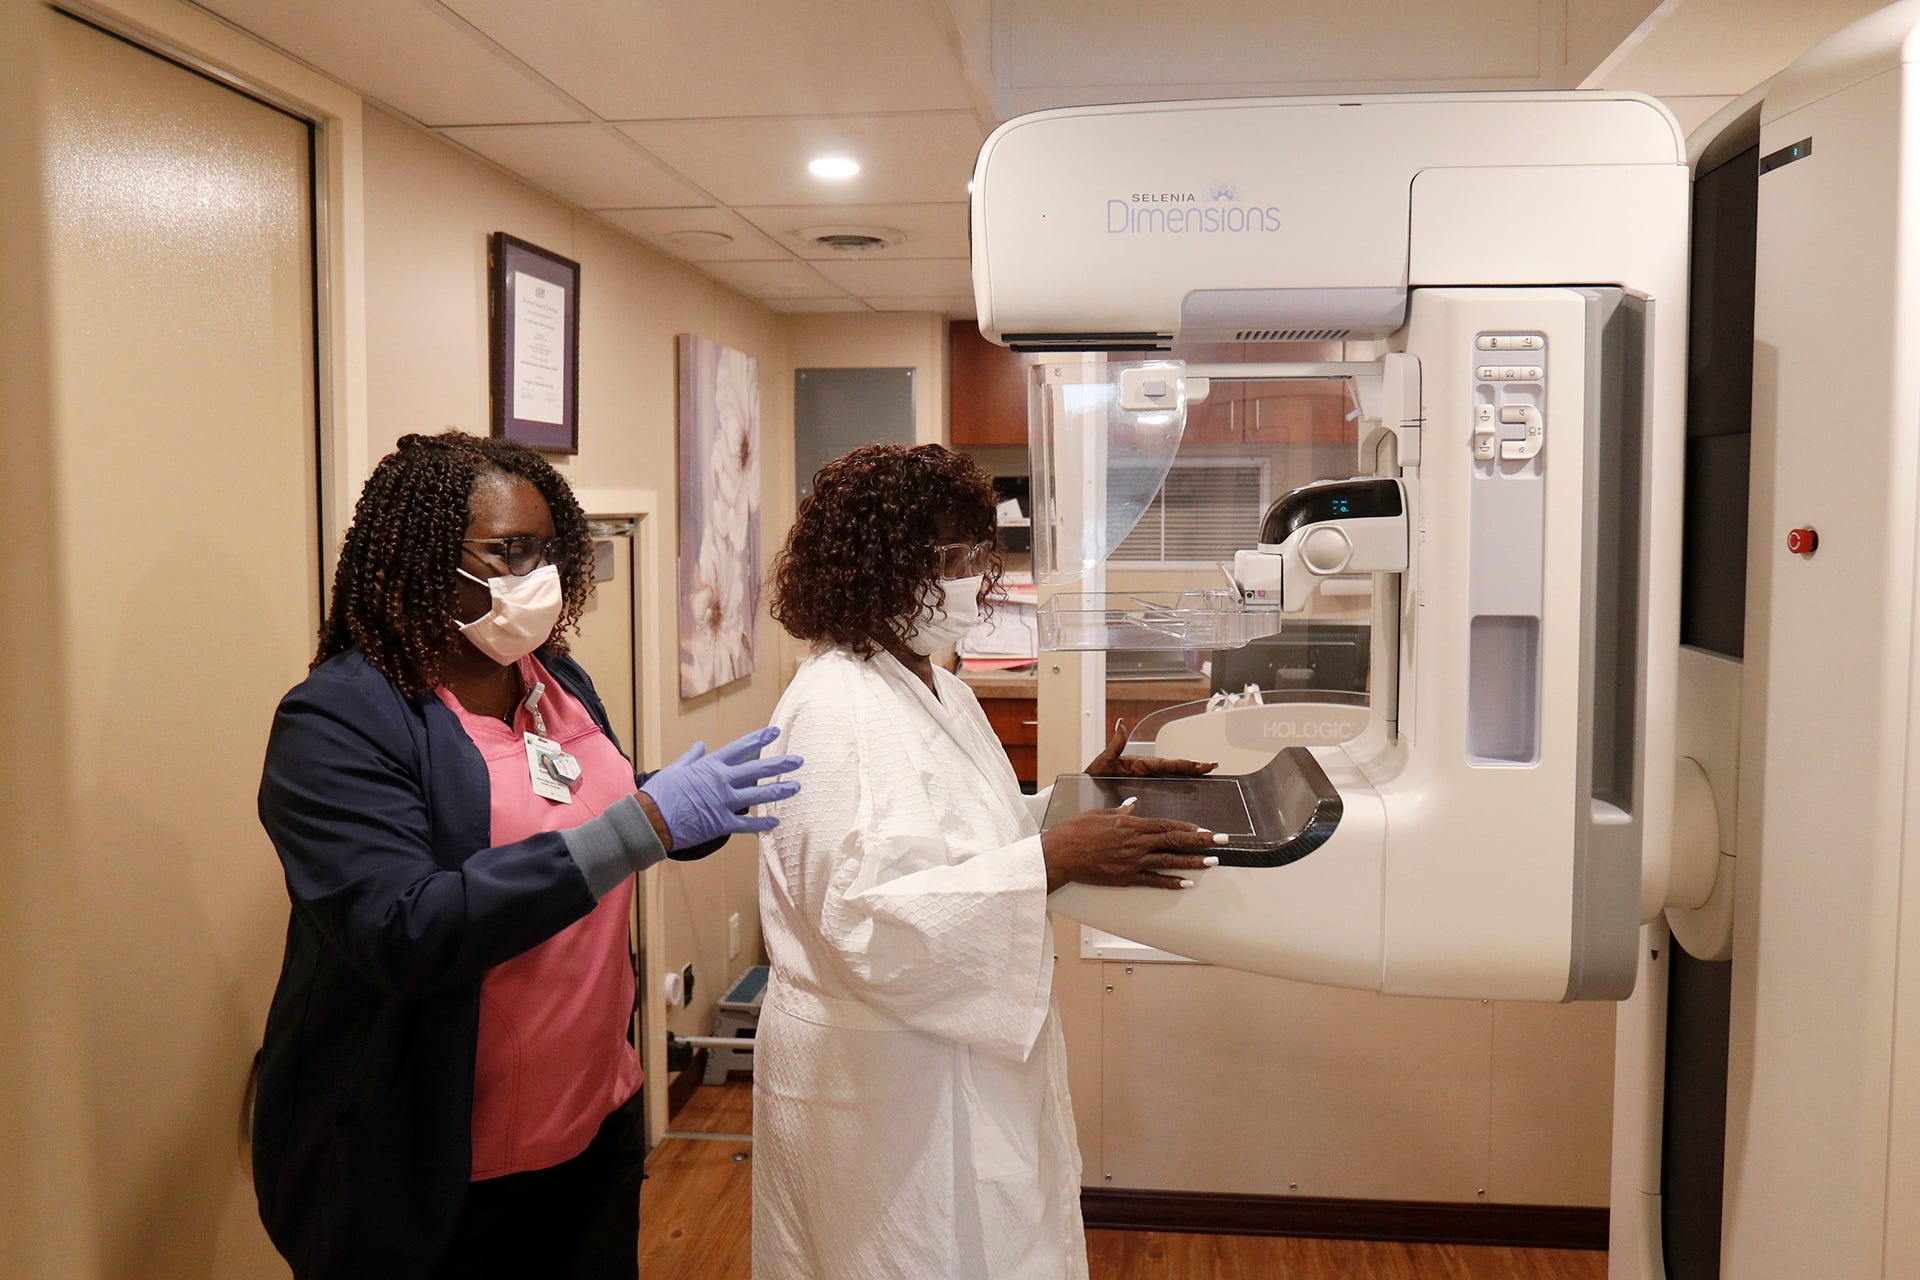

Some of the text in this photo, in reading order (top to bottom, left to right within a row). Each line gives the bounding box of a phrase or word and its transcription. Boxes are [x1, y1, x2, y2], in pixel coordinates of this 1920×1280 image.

[1132, 193, 1196, 202] SELENIA
[1107, 199, 1281, 233] Dimensions
[1263, 721, 1353, 738] HOLOGIC
